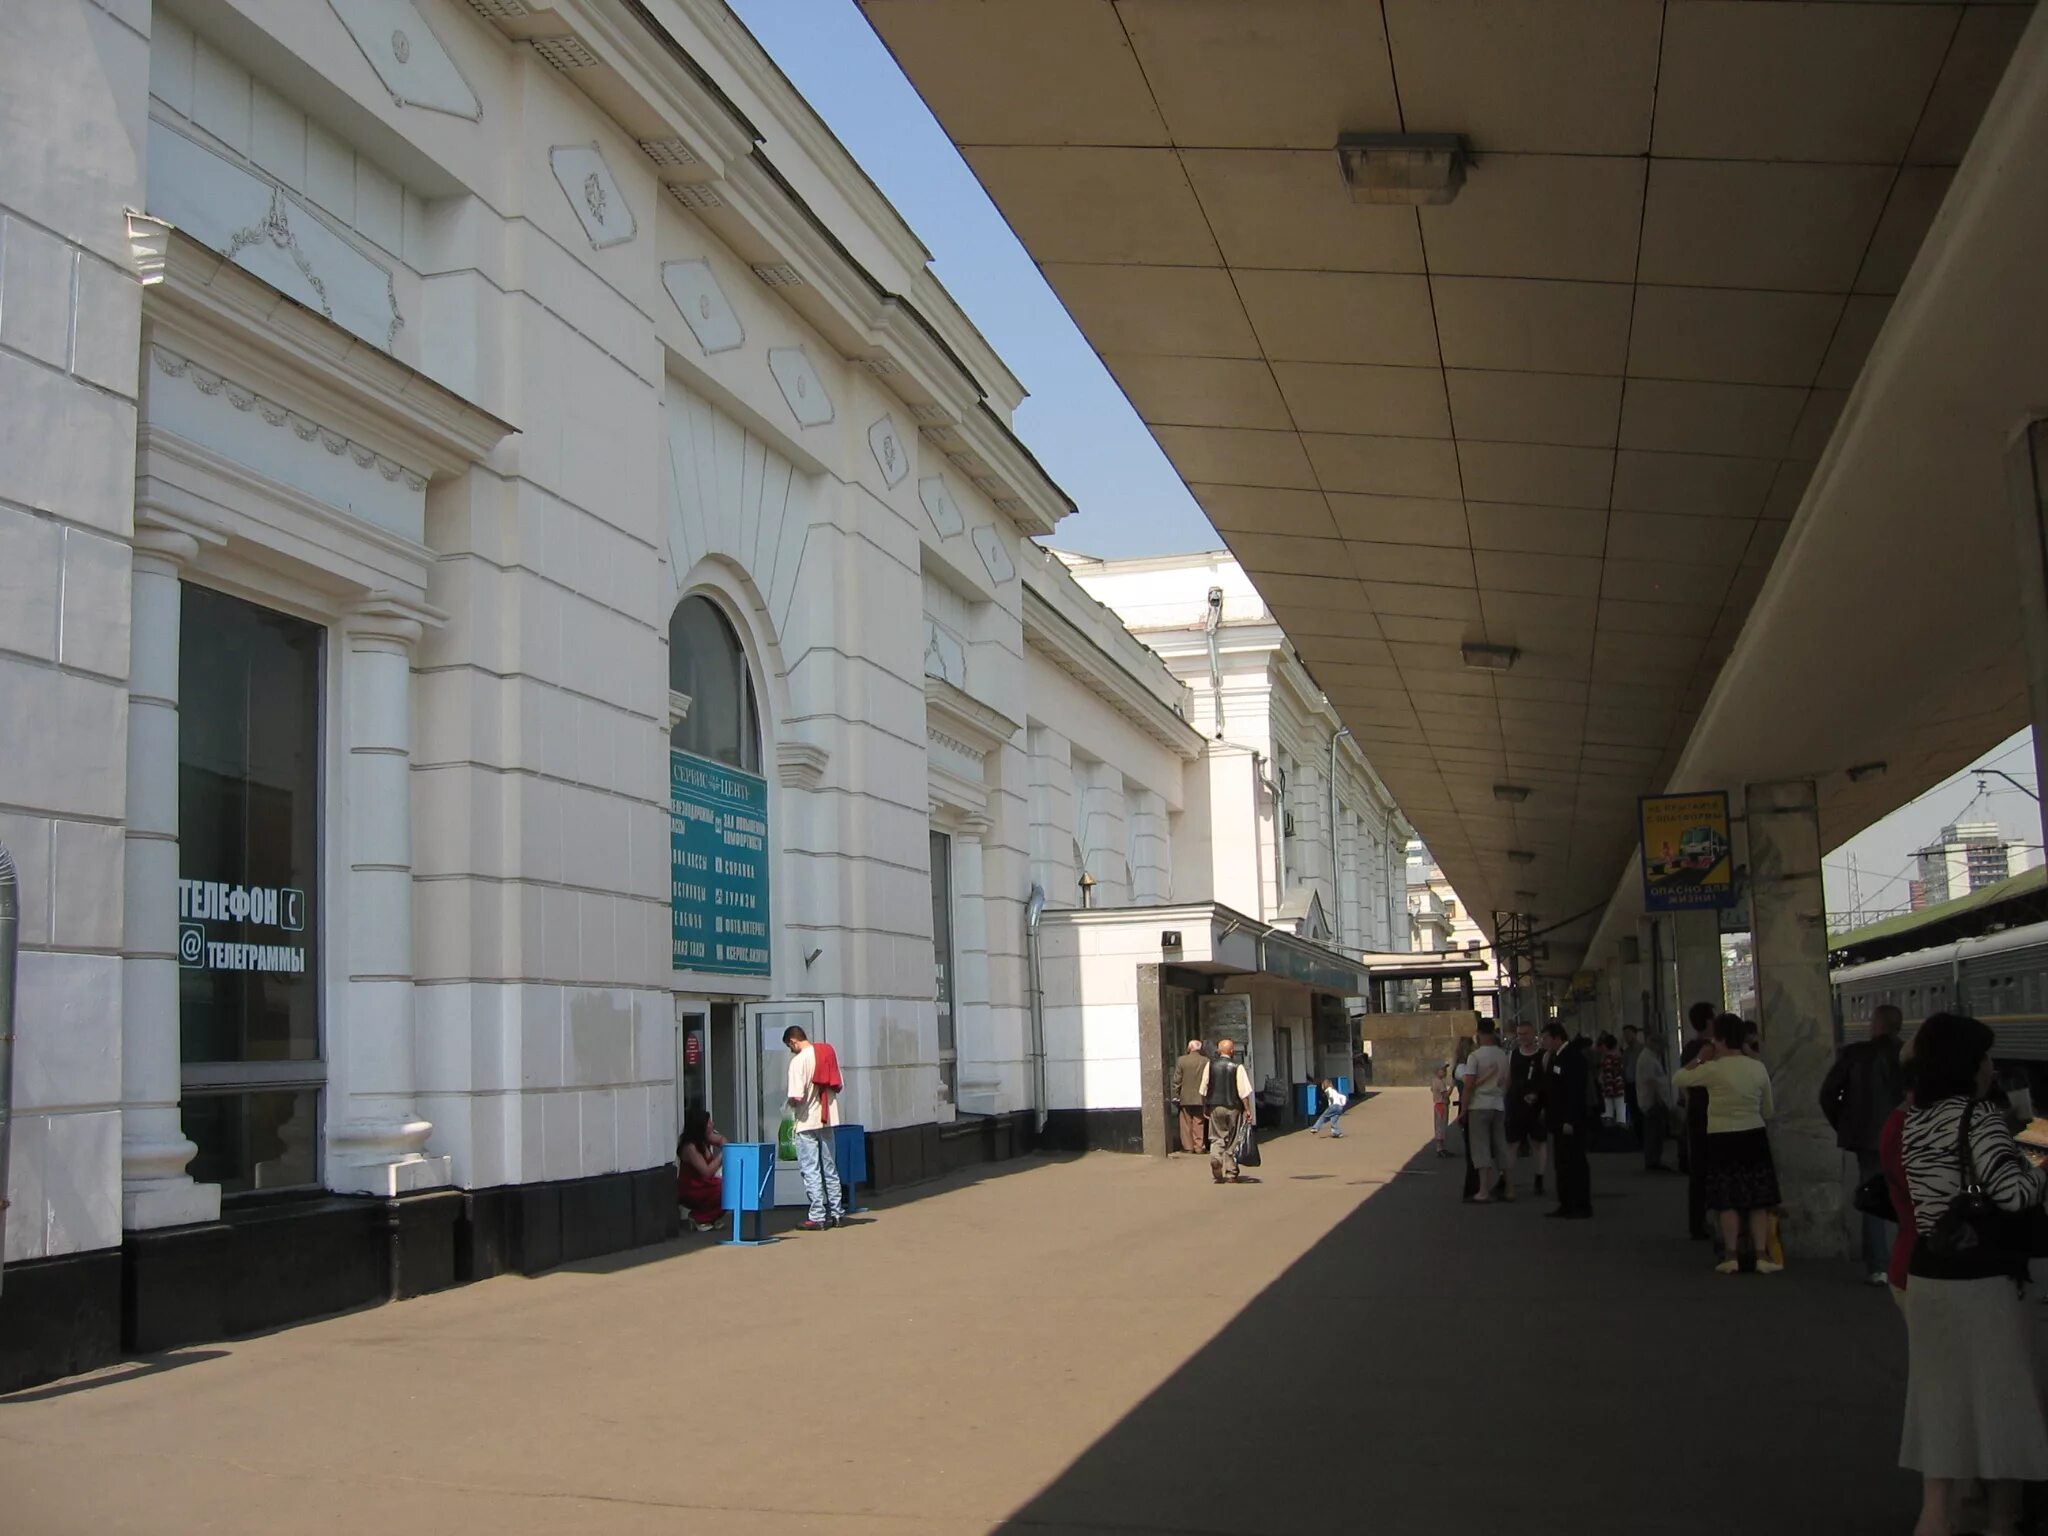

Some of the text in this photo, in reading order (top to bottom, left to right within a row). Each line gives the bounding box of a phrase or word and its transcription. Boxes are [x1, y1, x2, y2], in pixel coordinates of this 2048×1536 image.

[673, 764, 708, 789] СЕРВИС
[725, 860, 755, 879] СПРАВКА
[673, 881, 706, 902] ОСТИНИЦЫ
[1650, 884, 1702, 896] ОПАСНО
[179, 879, 277, 926] ТЕЛЕФОН
[725, 891, 756, 909] ТУРИЗМ
[674, 910, 702, 929] ЕЛЕФОН
[207, 942, 305, 972] ТЕЛЕГРАММЫ
[672, 939, 688, 956] АКАЗ
